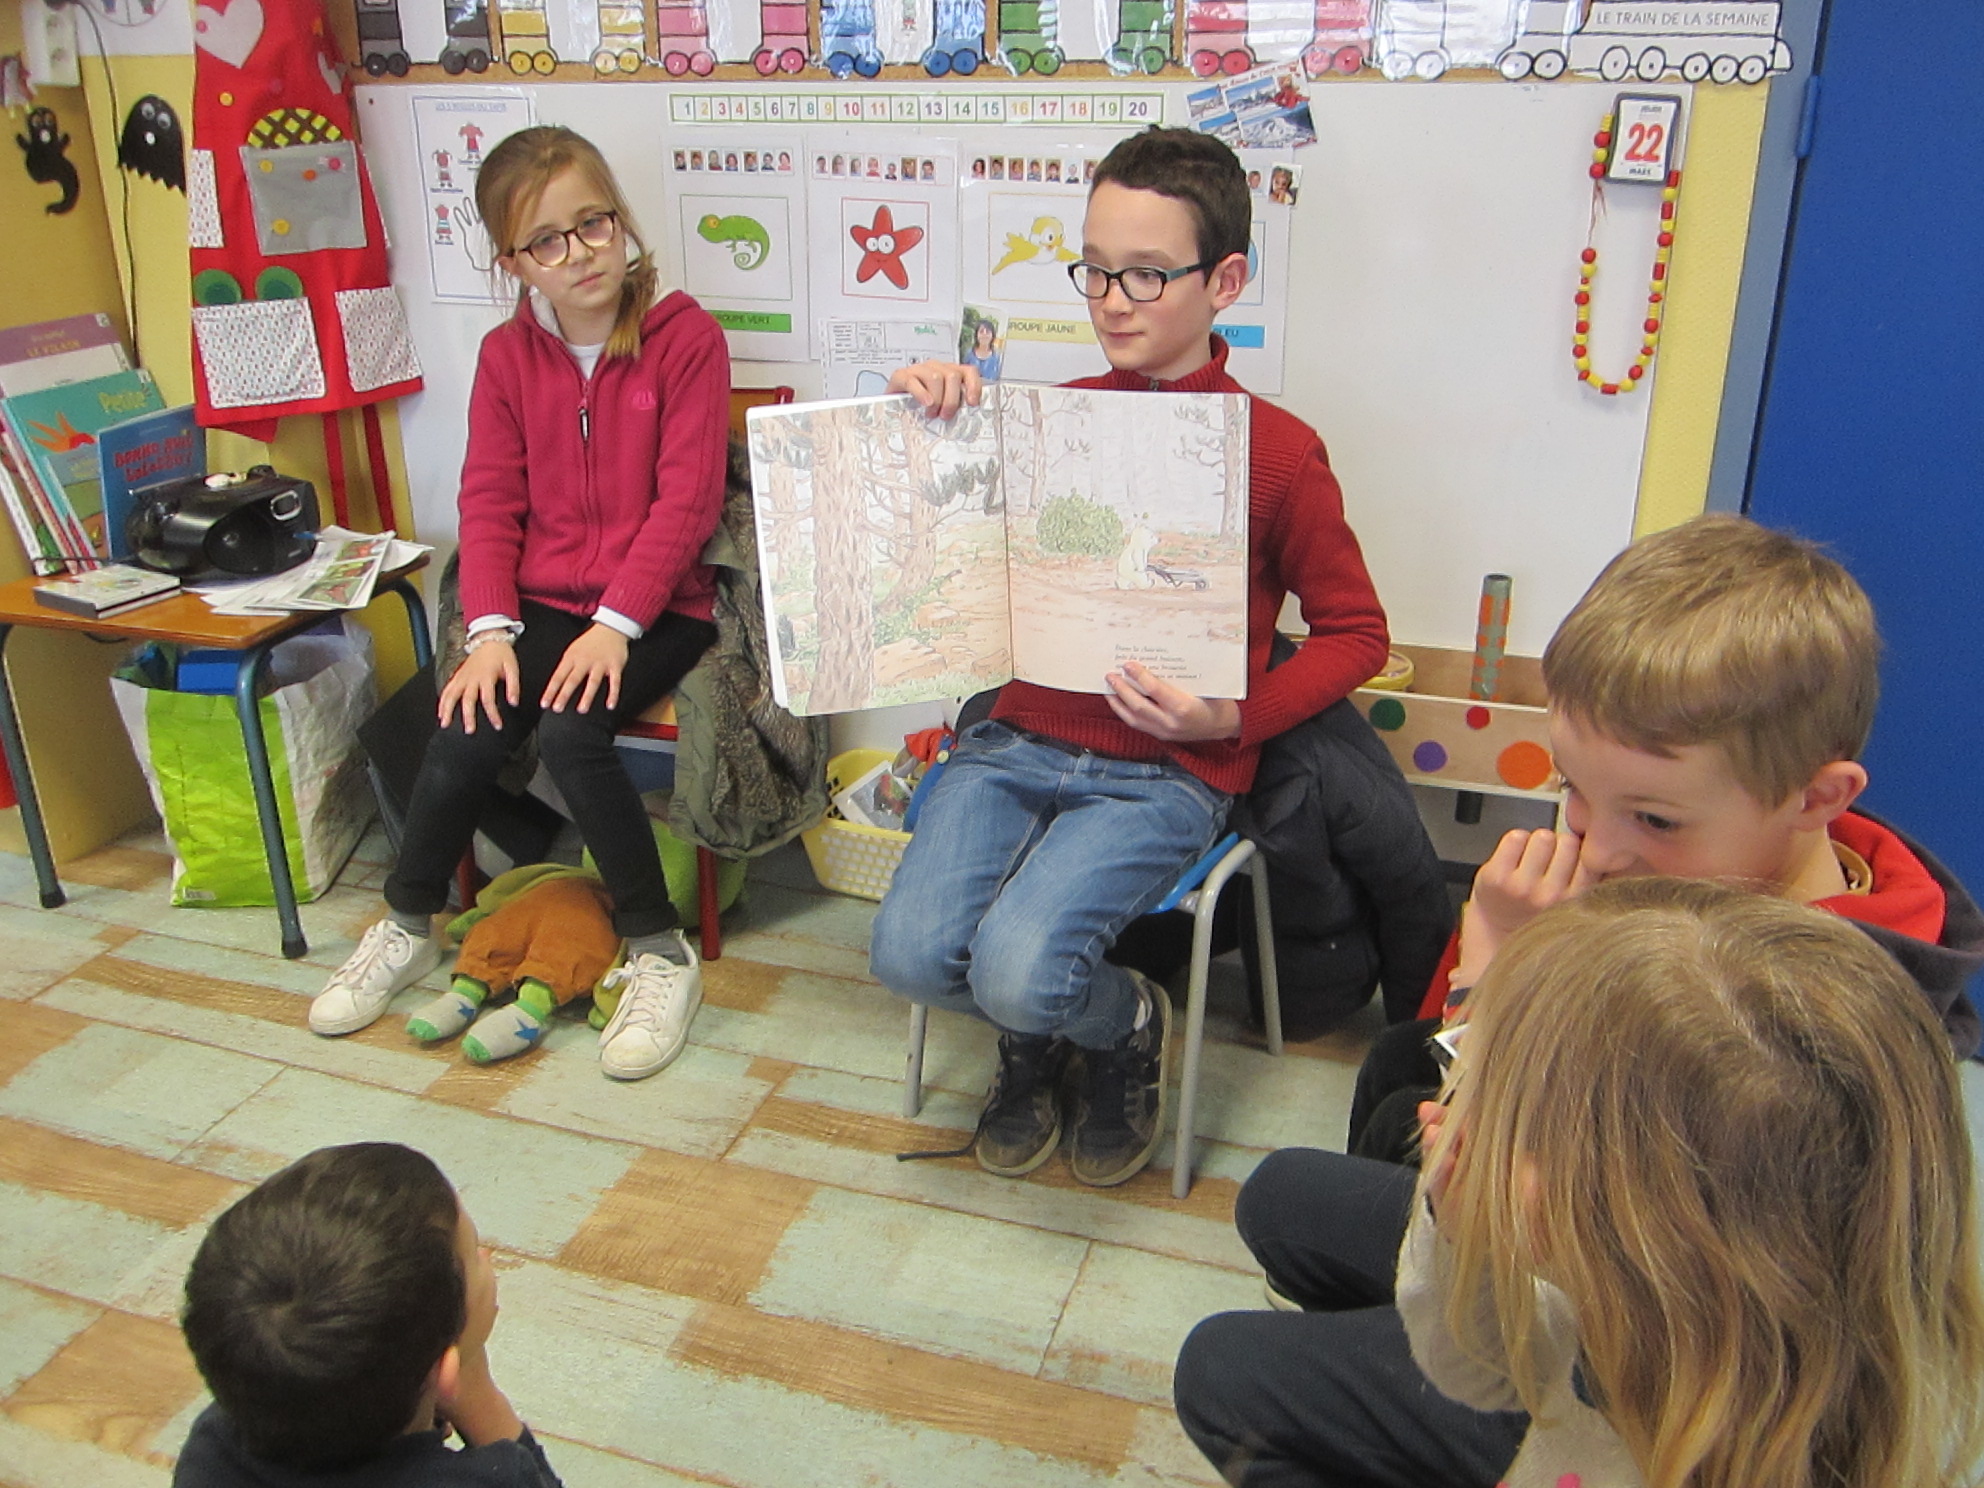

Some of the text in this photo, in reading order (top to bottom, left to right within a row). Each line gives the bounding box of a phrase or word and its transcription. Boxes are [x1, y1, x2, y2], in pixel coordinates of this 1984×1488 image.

[1596, 11, 1770, 27] LE TRAIN DE LA SEMAINE
[684, 102, 1147, 116] 1 2 3 4 5 6 7 8 9 10 11 12 13 14 15 16 17 18 19 20
[1625, 122, 1664, 162] 22
[714, 314, 770, 324] ROUPE VERT
[1045, 324, 1076, 334] JAUNE
